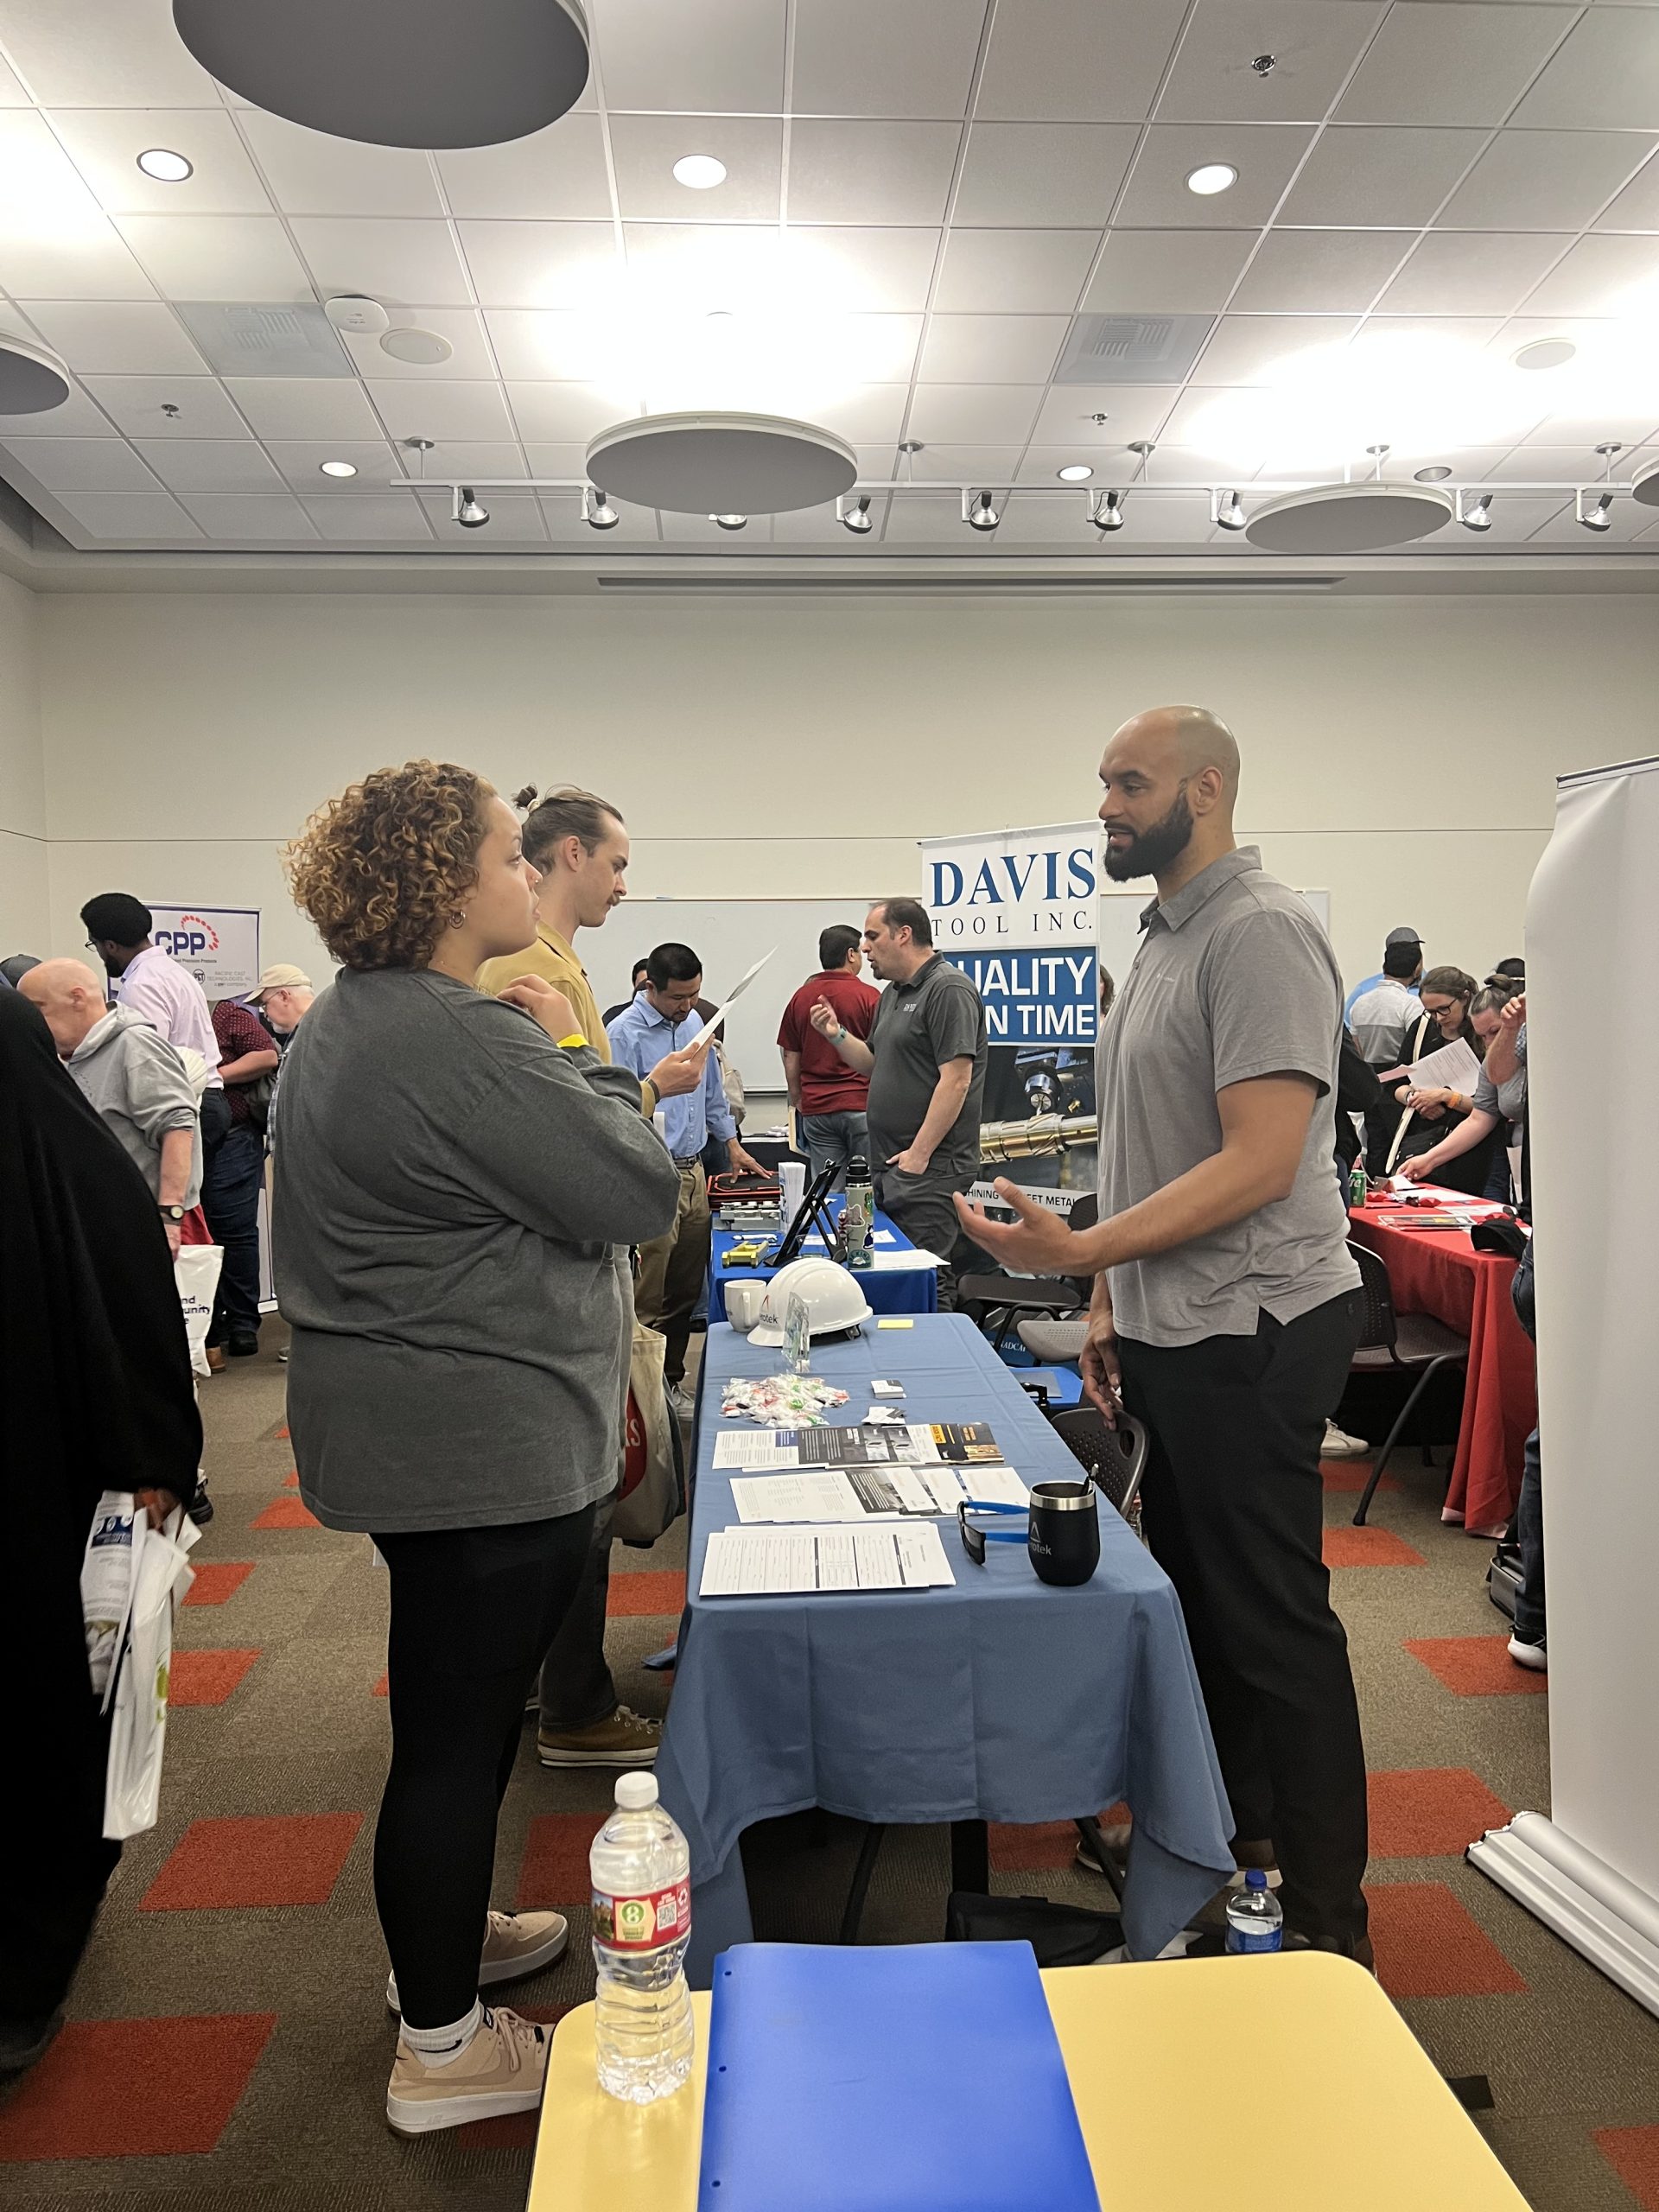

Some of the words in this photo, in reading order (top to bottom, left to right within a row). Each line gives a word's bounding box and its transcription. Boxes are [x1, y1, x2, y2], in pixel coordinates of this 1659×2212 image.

[929, 848, 1096, 907] DAVIS
[931, 915, 1008, 936] TOOL
[1033, 911, 1092, 931] INC.
[156, 931, 206, 956] CPP
[945, 956, 1093, 996] UALITY
[986, 1005, 1008, 1035] N
[1016, 1005, 1095, 1036] TIME
[968, 1189, 999, 1199] HINING
[184, 1304, 211, 1315] unity
